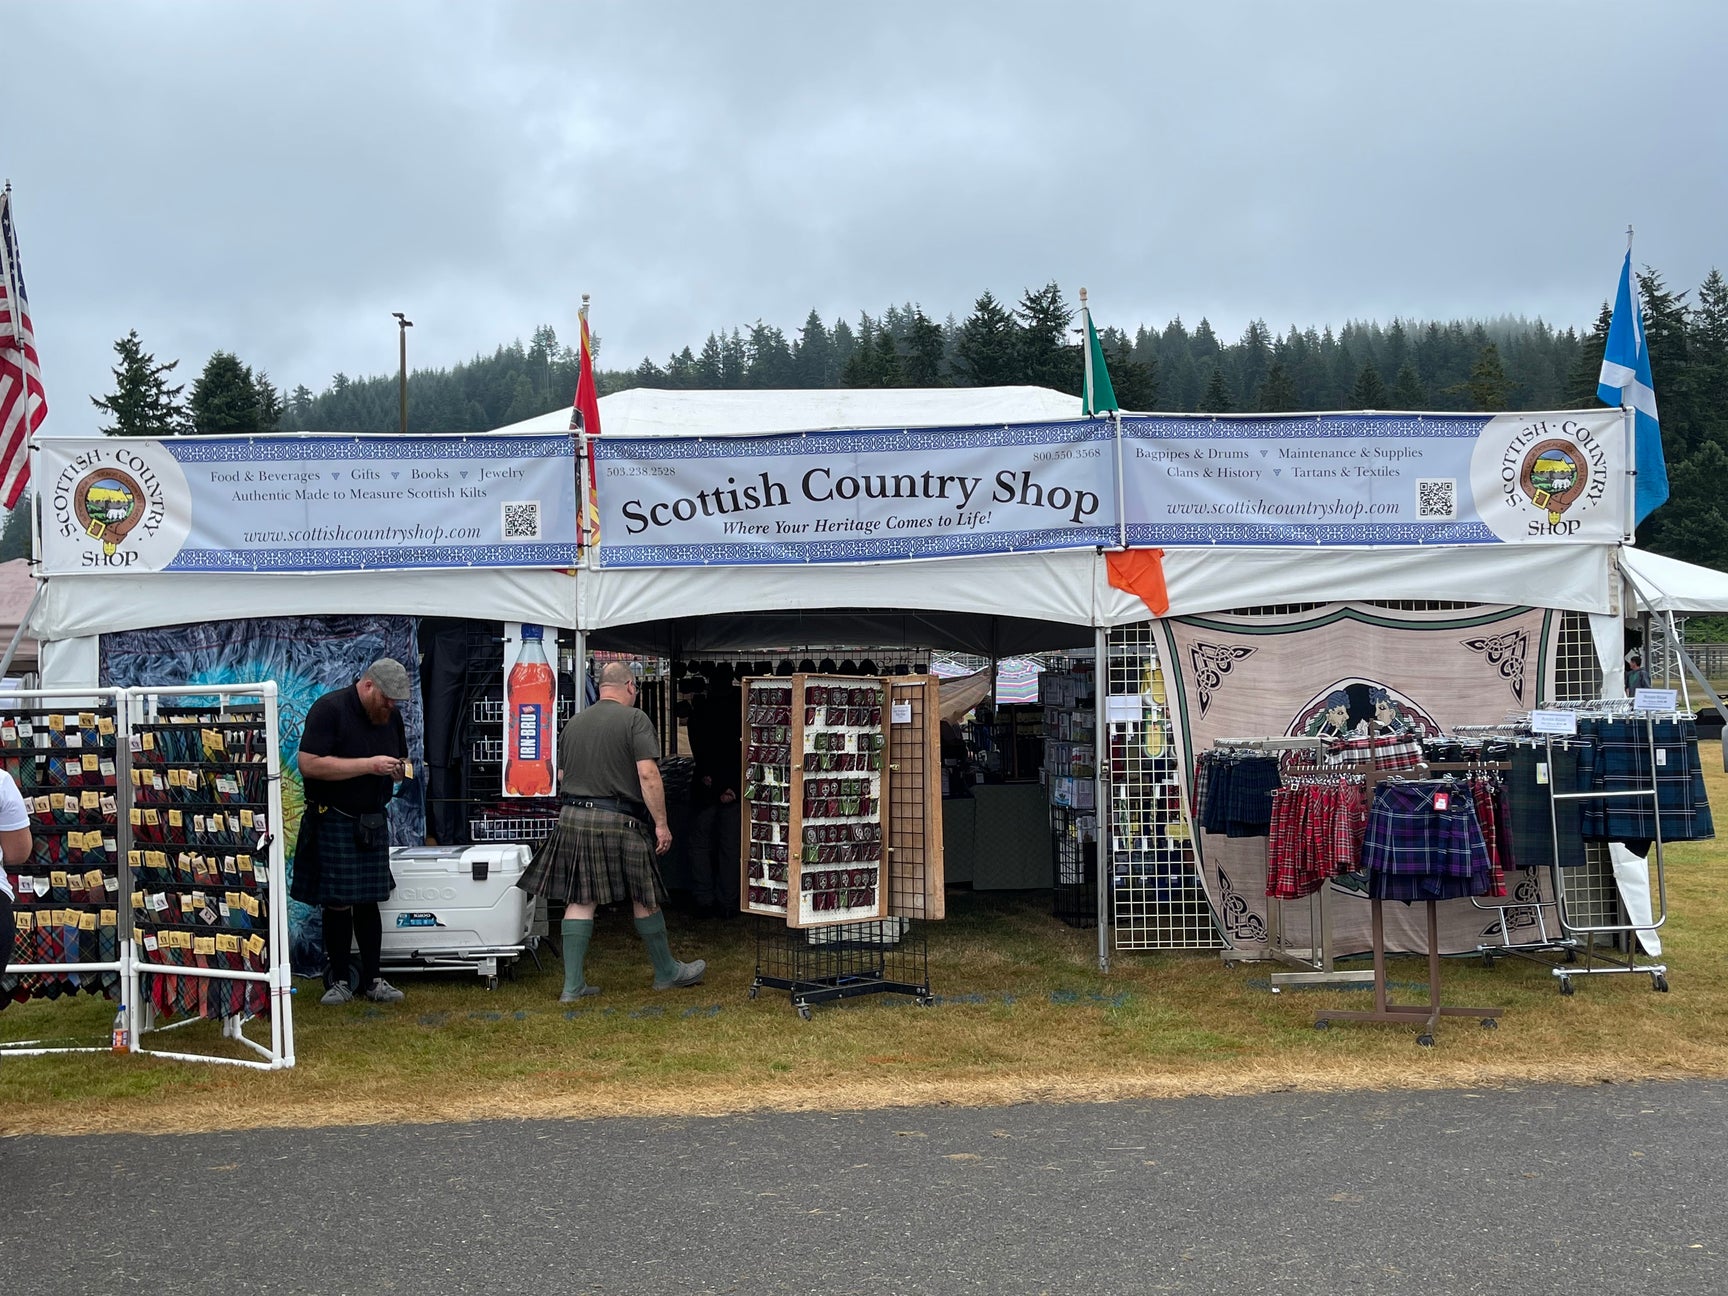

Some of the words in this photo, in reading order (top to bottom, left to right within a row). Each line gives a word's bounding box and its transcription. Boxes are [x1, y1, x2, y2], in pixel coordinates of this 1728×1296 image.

[1033, 448, 1101, 462] 800.550.3568
[1135, 448, 1190, 462] Bagpipes
[1193, 448, 1204, 459] &
[1207, 448, 1249, 459] Drums
[1278, 447, 1357, 459] Maintenance
[1360, 447, 1371, 458] &
[1374, 447, 1423, 461] Supplies
[606, 467, 676, 477] 503.238.2528
[1502, 421, 1548, 508] SCOTTISH
[1562, 420, 1607, 507] COUNTRY
[210, 471, 240, 482] Food
[244, 471, 255, 482] &
[258, 470, 321, 484] Beverages
[351, 468, 380, 480] Gifts
[411, 468, 449, 480] Books
[478, 467, 525, 481] Jewelry
[1166, 467, 1199, 478] Clans
[1202, 467, 1213, 478] &
[1217, 467, 1262, 480] History
[1291, 466, 1337, 478] Tartans
[1340, 466, 1351, 477] &
[1353, 466, 1400, 477] Textiles
[53, 448, 101, 538] SCOTTISH
[116, 449, 165, 538] COUNTRY
[231, 490, 291, 502] Authentic
[295, 489, 330, 501] Made
[333, 490, 346, 499] to
[350, 488, 404, 500] Measure
[407, 487, 455, 499] Scottish
[459, 487, 487, 498] Kilts
[621, 471, 791, 535] Scottish
[801, 467, 983, 510] Country
[992, 470, 1100, 524] Shop
[1166, 498, 1399, 520] www.scottishcountryshop.com
[723, 521, 770, 535] Where
[775, 520, 809, 535] Your
[813, 518, 881, 535] Heritage
[886, 515, 933, 530] Comes
[938, 515, 952, 528] to
[956, 511, 992, 530] Life!
[1527, 519, 1581, 536] SHOP
[243, 523, 481, 545] www.scottishcountryshop.com
[81, 550, 139, 567] SHOP
